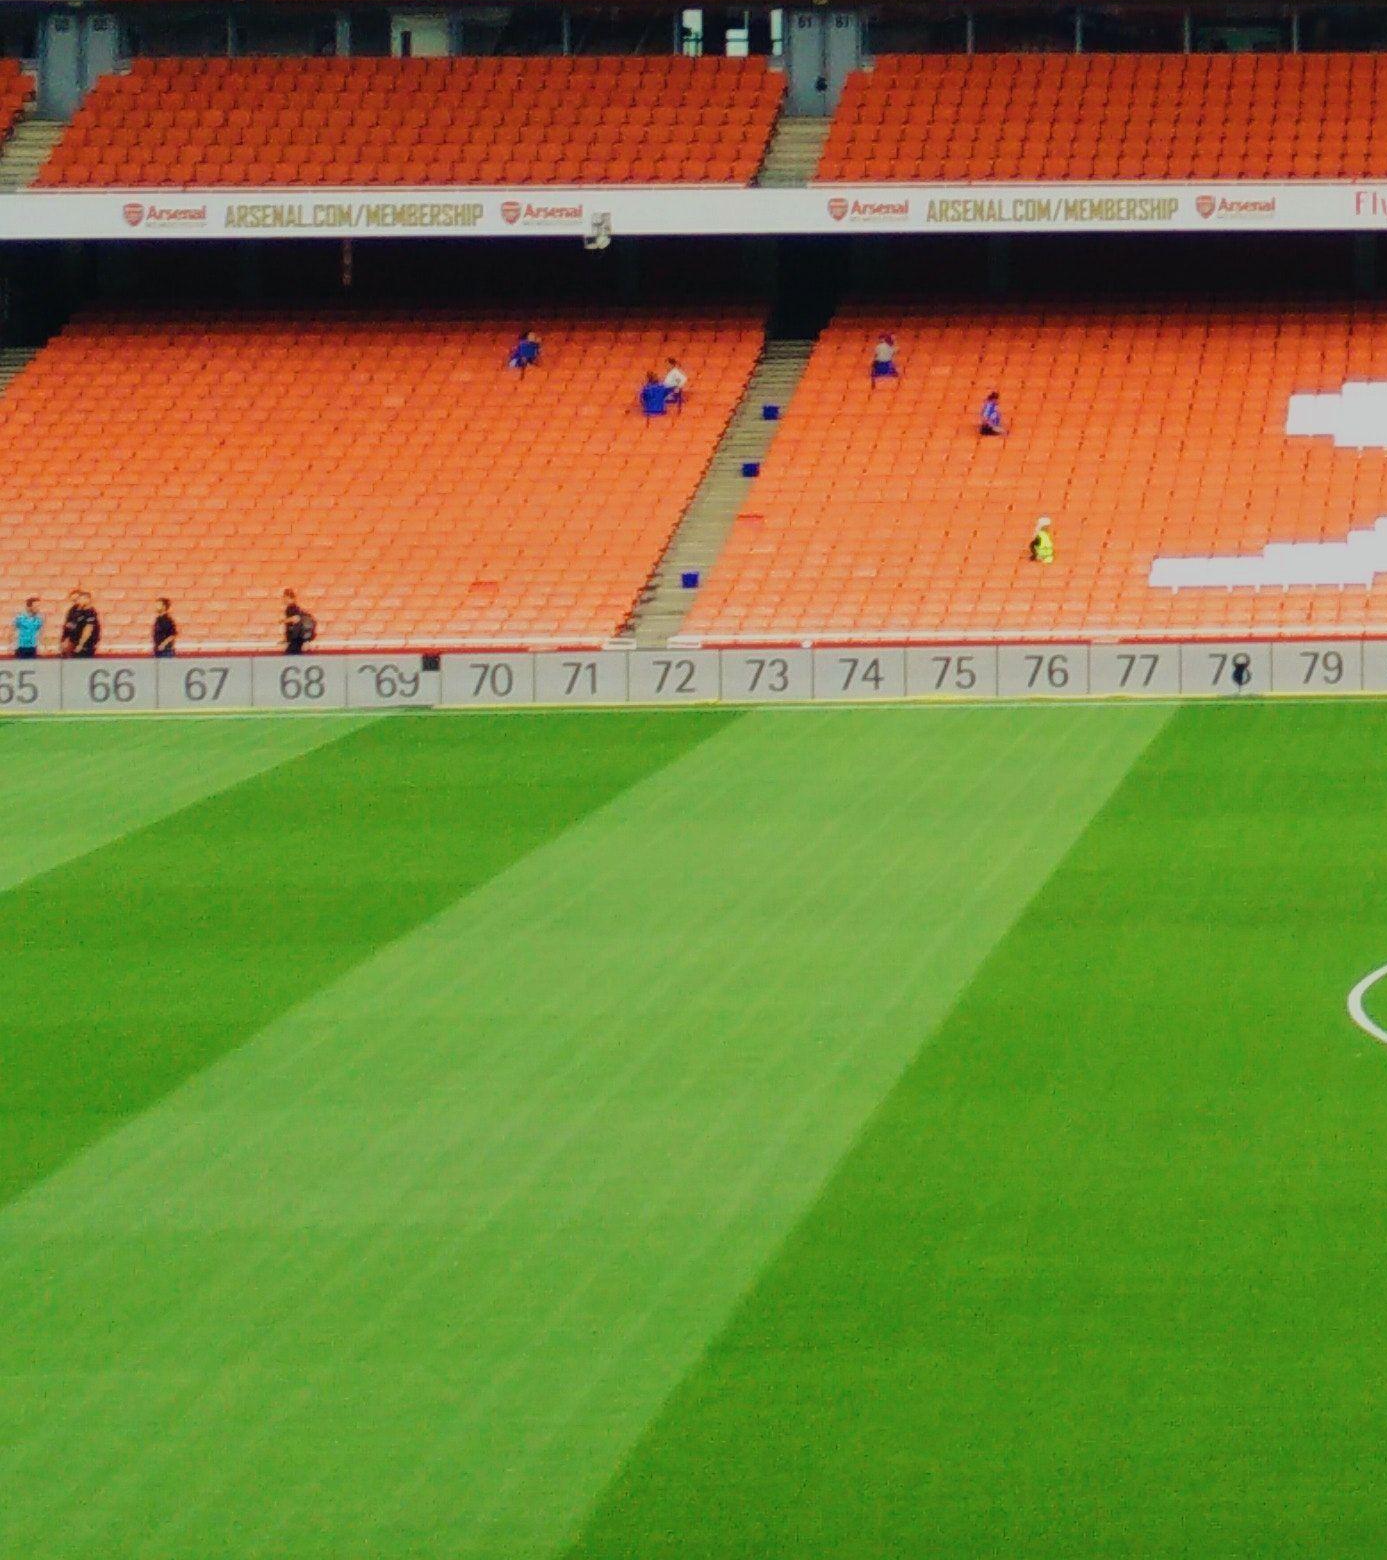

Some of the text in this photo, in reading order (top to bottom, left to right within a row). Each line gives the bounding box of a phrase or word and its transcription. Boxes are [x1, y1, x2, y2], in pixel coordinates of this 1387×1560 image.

[146, 205, 206, 221] Arsenal
[225, 204, 484, 228] ARSENAL.COM/MEMBERSHIP
[523, 203, 584, 219] Arsenal
[851, 199, 909, 215] Arsenal
[926, 198, 1179, 223] ARSENAL.COM/MEMBERSHIP
[1218, 196, 1276, 212] Arsenal
[185, 668, 231, 703] 67
[281, 666, 326, 701] 68
[471, 663, 515, 698] 70
[563, 662, 598, 696] 71
[653, 660, 696, 695] 72
[746, 659, 790, 693] 73
[840, 658, 885, 692] 74
[933, 657, 977, 691] 75
[1026, 655, 1070, 689] 76
[1117, 655, 1161, 688] 77
[1301, 652, 1345, 686] 79
[89, 669, 136, 704] 66
